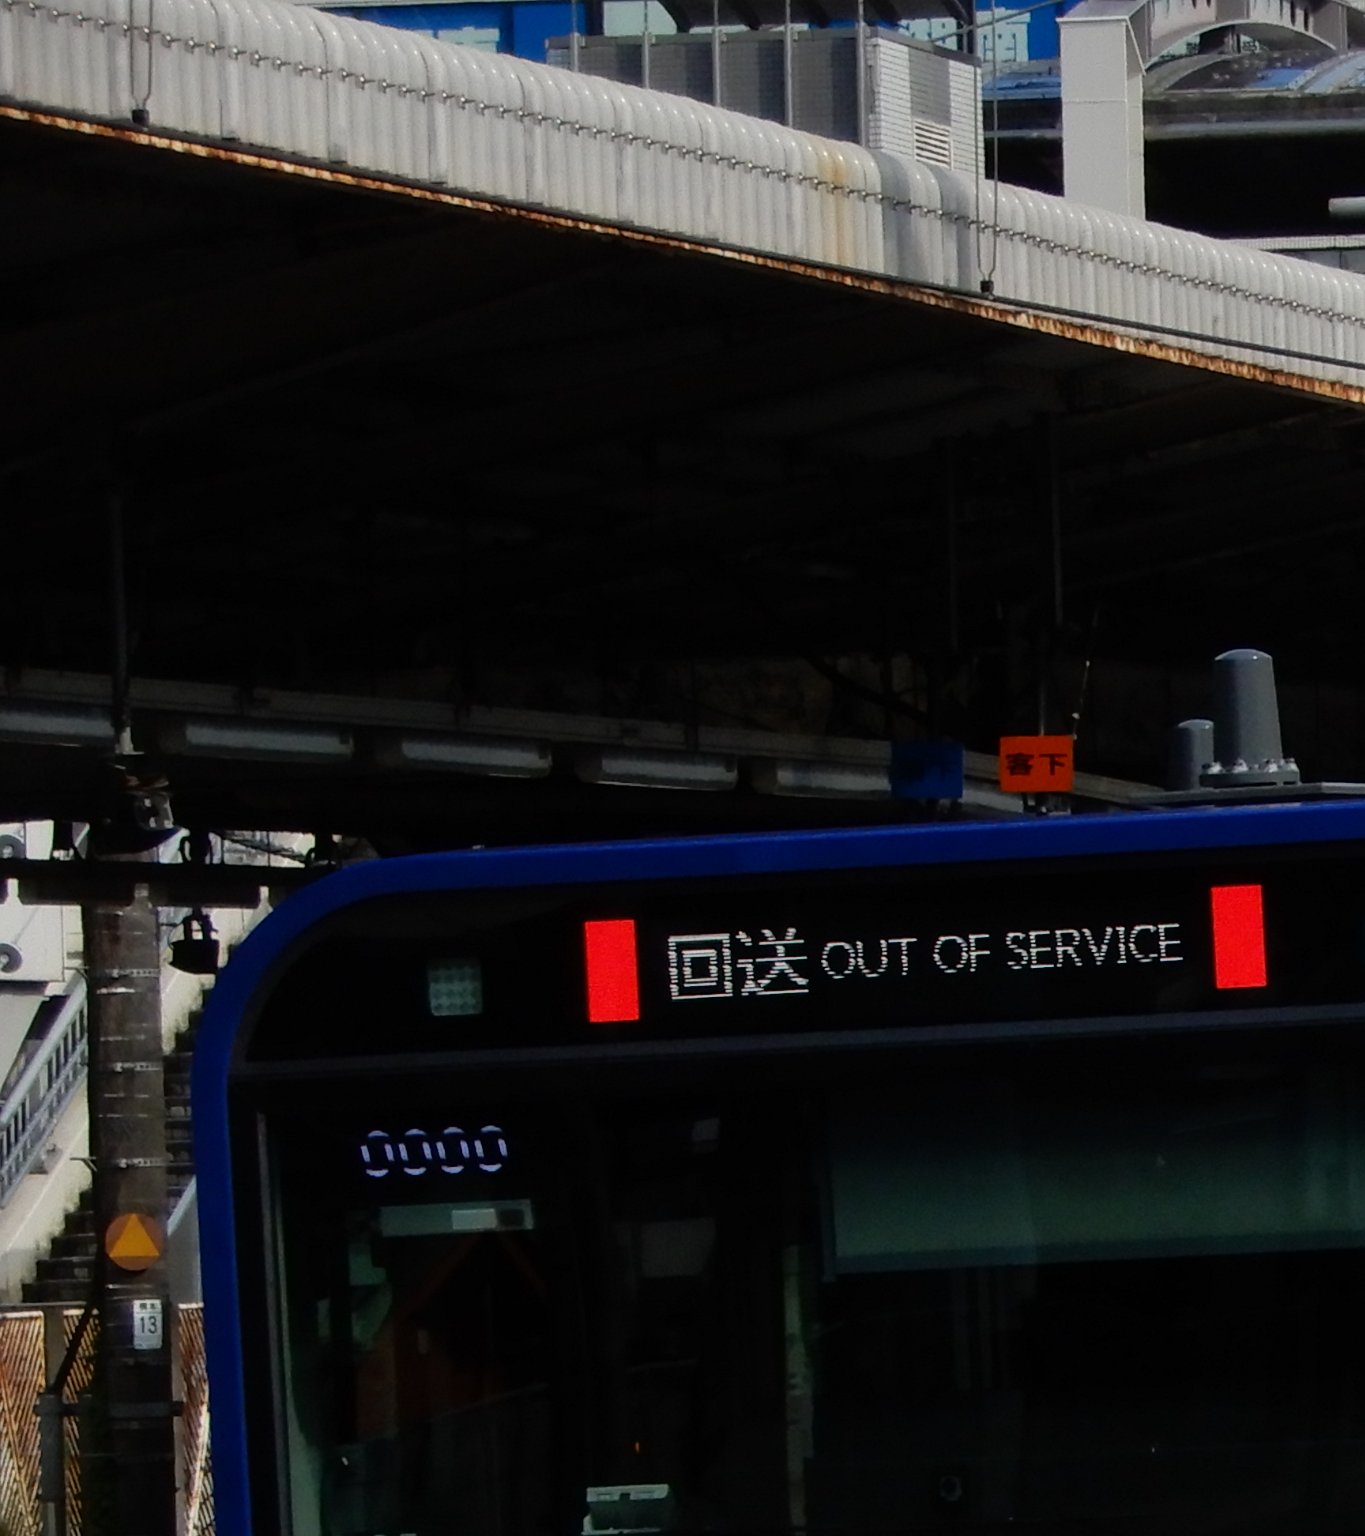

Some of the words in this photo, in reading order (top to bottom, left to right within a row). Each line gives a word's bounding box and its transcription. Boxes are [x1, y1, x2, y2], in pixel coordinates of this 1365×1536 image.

[667, 927, 809, 1000] 回送
[821, 929, 917, 979] OUT
[933, 934, 990, 973] OF
[1005, 923, 1184, 970] SERVICE
[360, 1124, 508, 1177] 0000
[140, 1315, 157, 1335] 13
